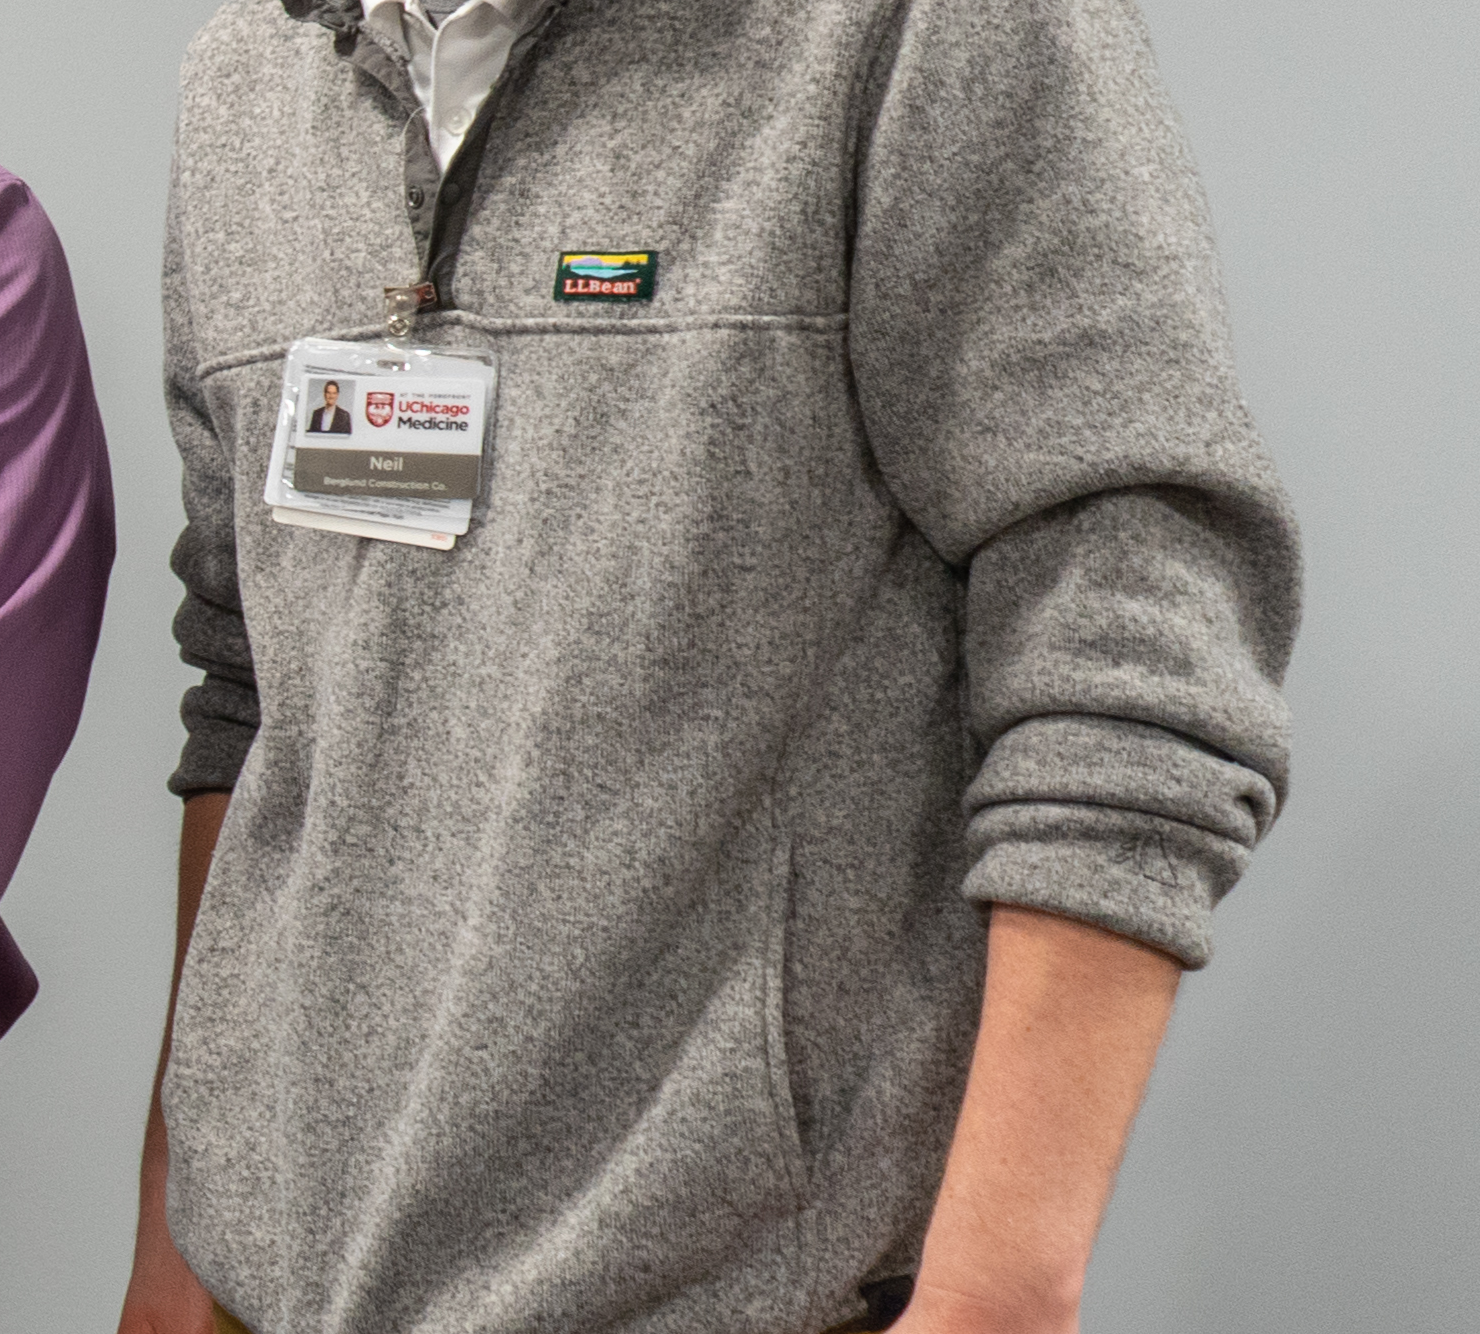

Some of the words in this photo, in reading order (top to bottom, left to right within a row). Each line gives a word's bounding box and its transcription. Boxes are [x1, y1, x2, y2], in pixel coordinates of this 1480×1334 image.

[398, 401, 470, 418] UChicago
[397, 416, 469, 432] Medicine
[369, 456, 404, 471] Neil
